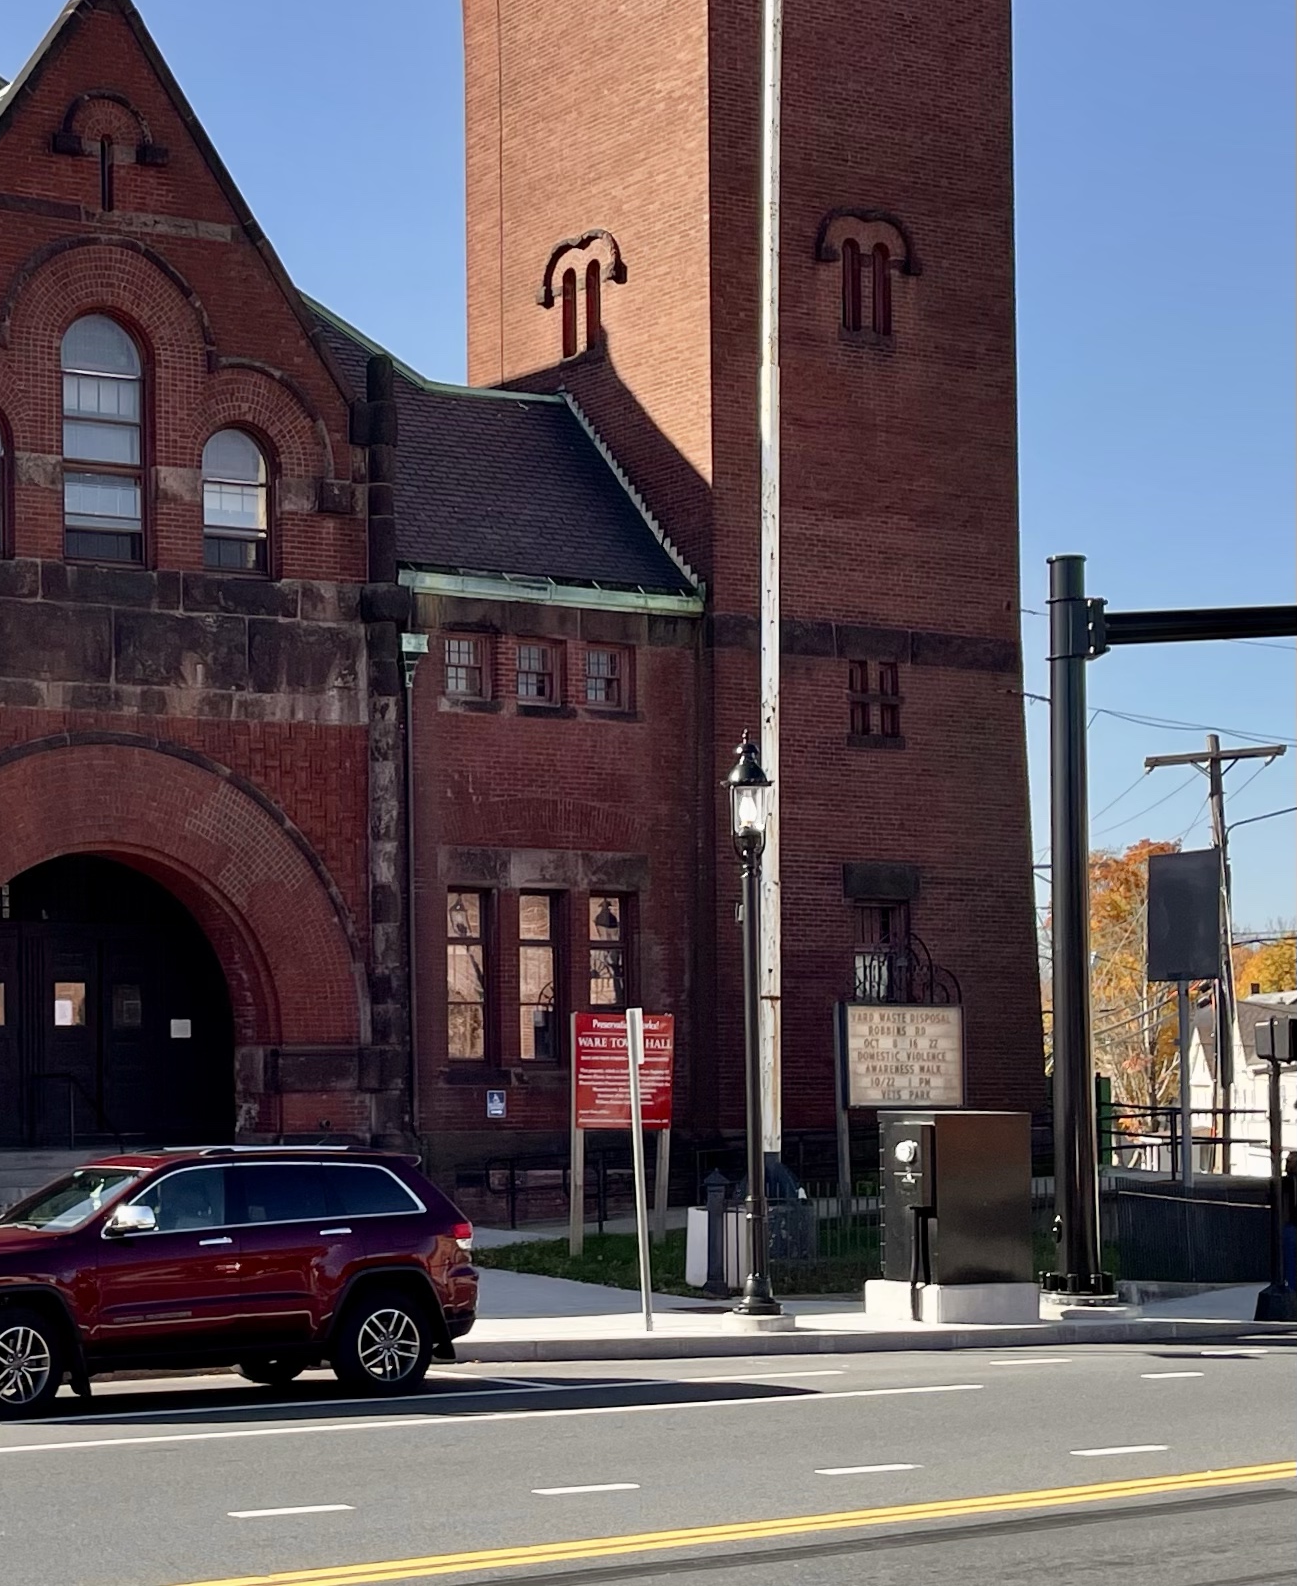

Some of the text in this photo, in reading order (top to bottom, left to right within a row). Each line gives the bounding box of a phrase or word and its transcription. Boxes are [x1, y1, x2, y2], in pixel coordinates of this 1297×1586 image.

[852, 1013, 951, 1024] YARD WASTE DISPOSAL
[592, 1019, 629, 1030] Preservati
[868, 1025, 926, 1036] ROBBINS RD
[577, 1036, 608, 1048] WARE
[645, 1038, 673, 1050] HALL
[864, 1038, 880, 1049] OCT
[909, 1038, 918, 1049] 16
[929, 1038, 939, 1049] 22
[857, 1051, 946, 1062] DOMESTIC VIOLENCE
[865, 1064, 942, 1075] AWARENESS WALK
[871, 1077, 895, 1087] 10/22
[919, 1077, 931, 1087] PM
[881, 1089, 931, 1100] VETS PARK
